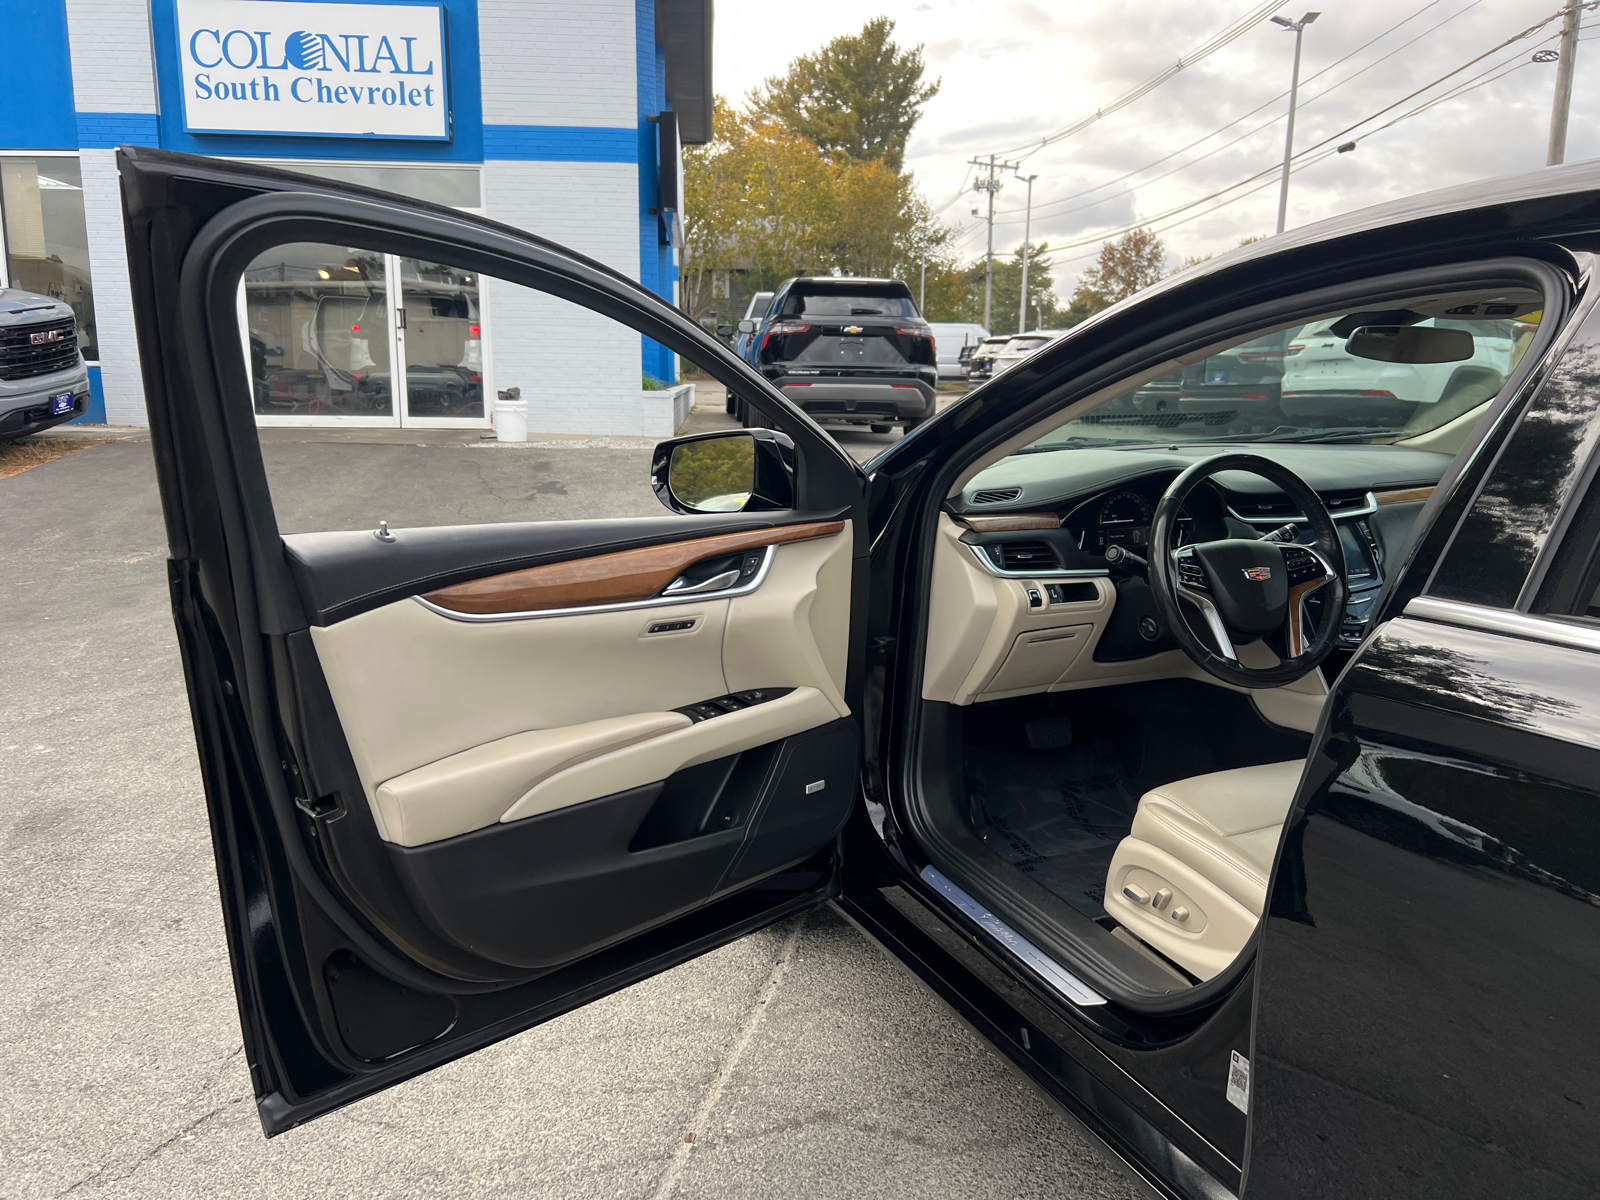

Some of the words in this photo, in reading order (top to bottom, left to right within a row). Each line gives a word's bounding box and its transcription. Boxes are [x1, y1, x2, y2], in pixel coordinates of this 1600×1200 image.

[190, 28, 434, 76] COLONIAL
[194, 73, 281, 102] South
[290, 76, 435, 107] Chevrolet
[30, 329, 65, 345] GMC
